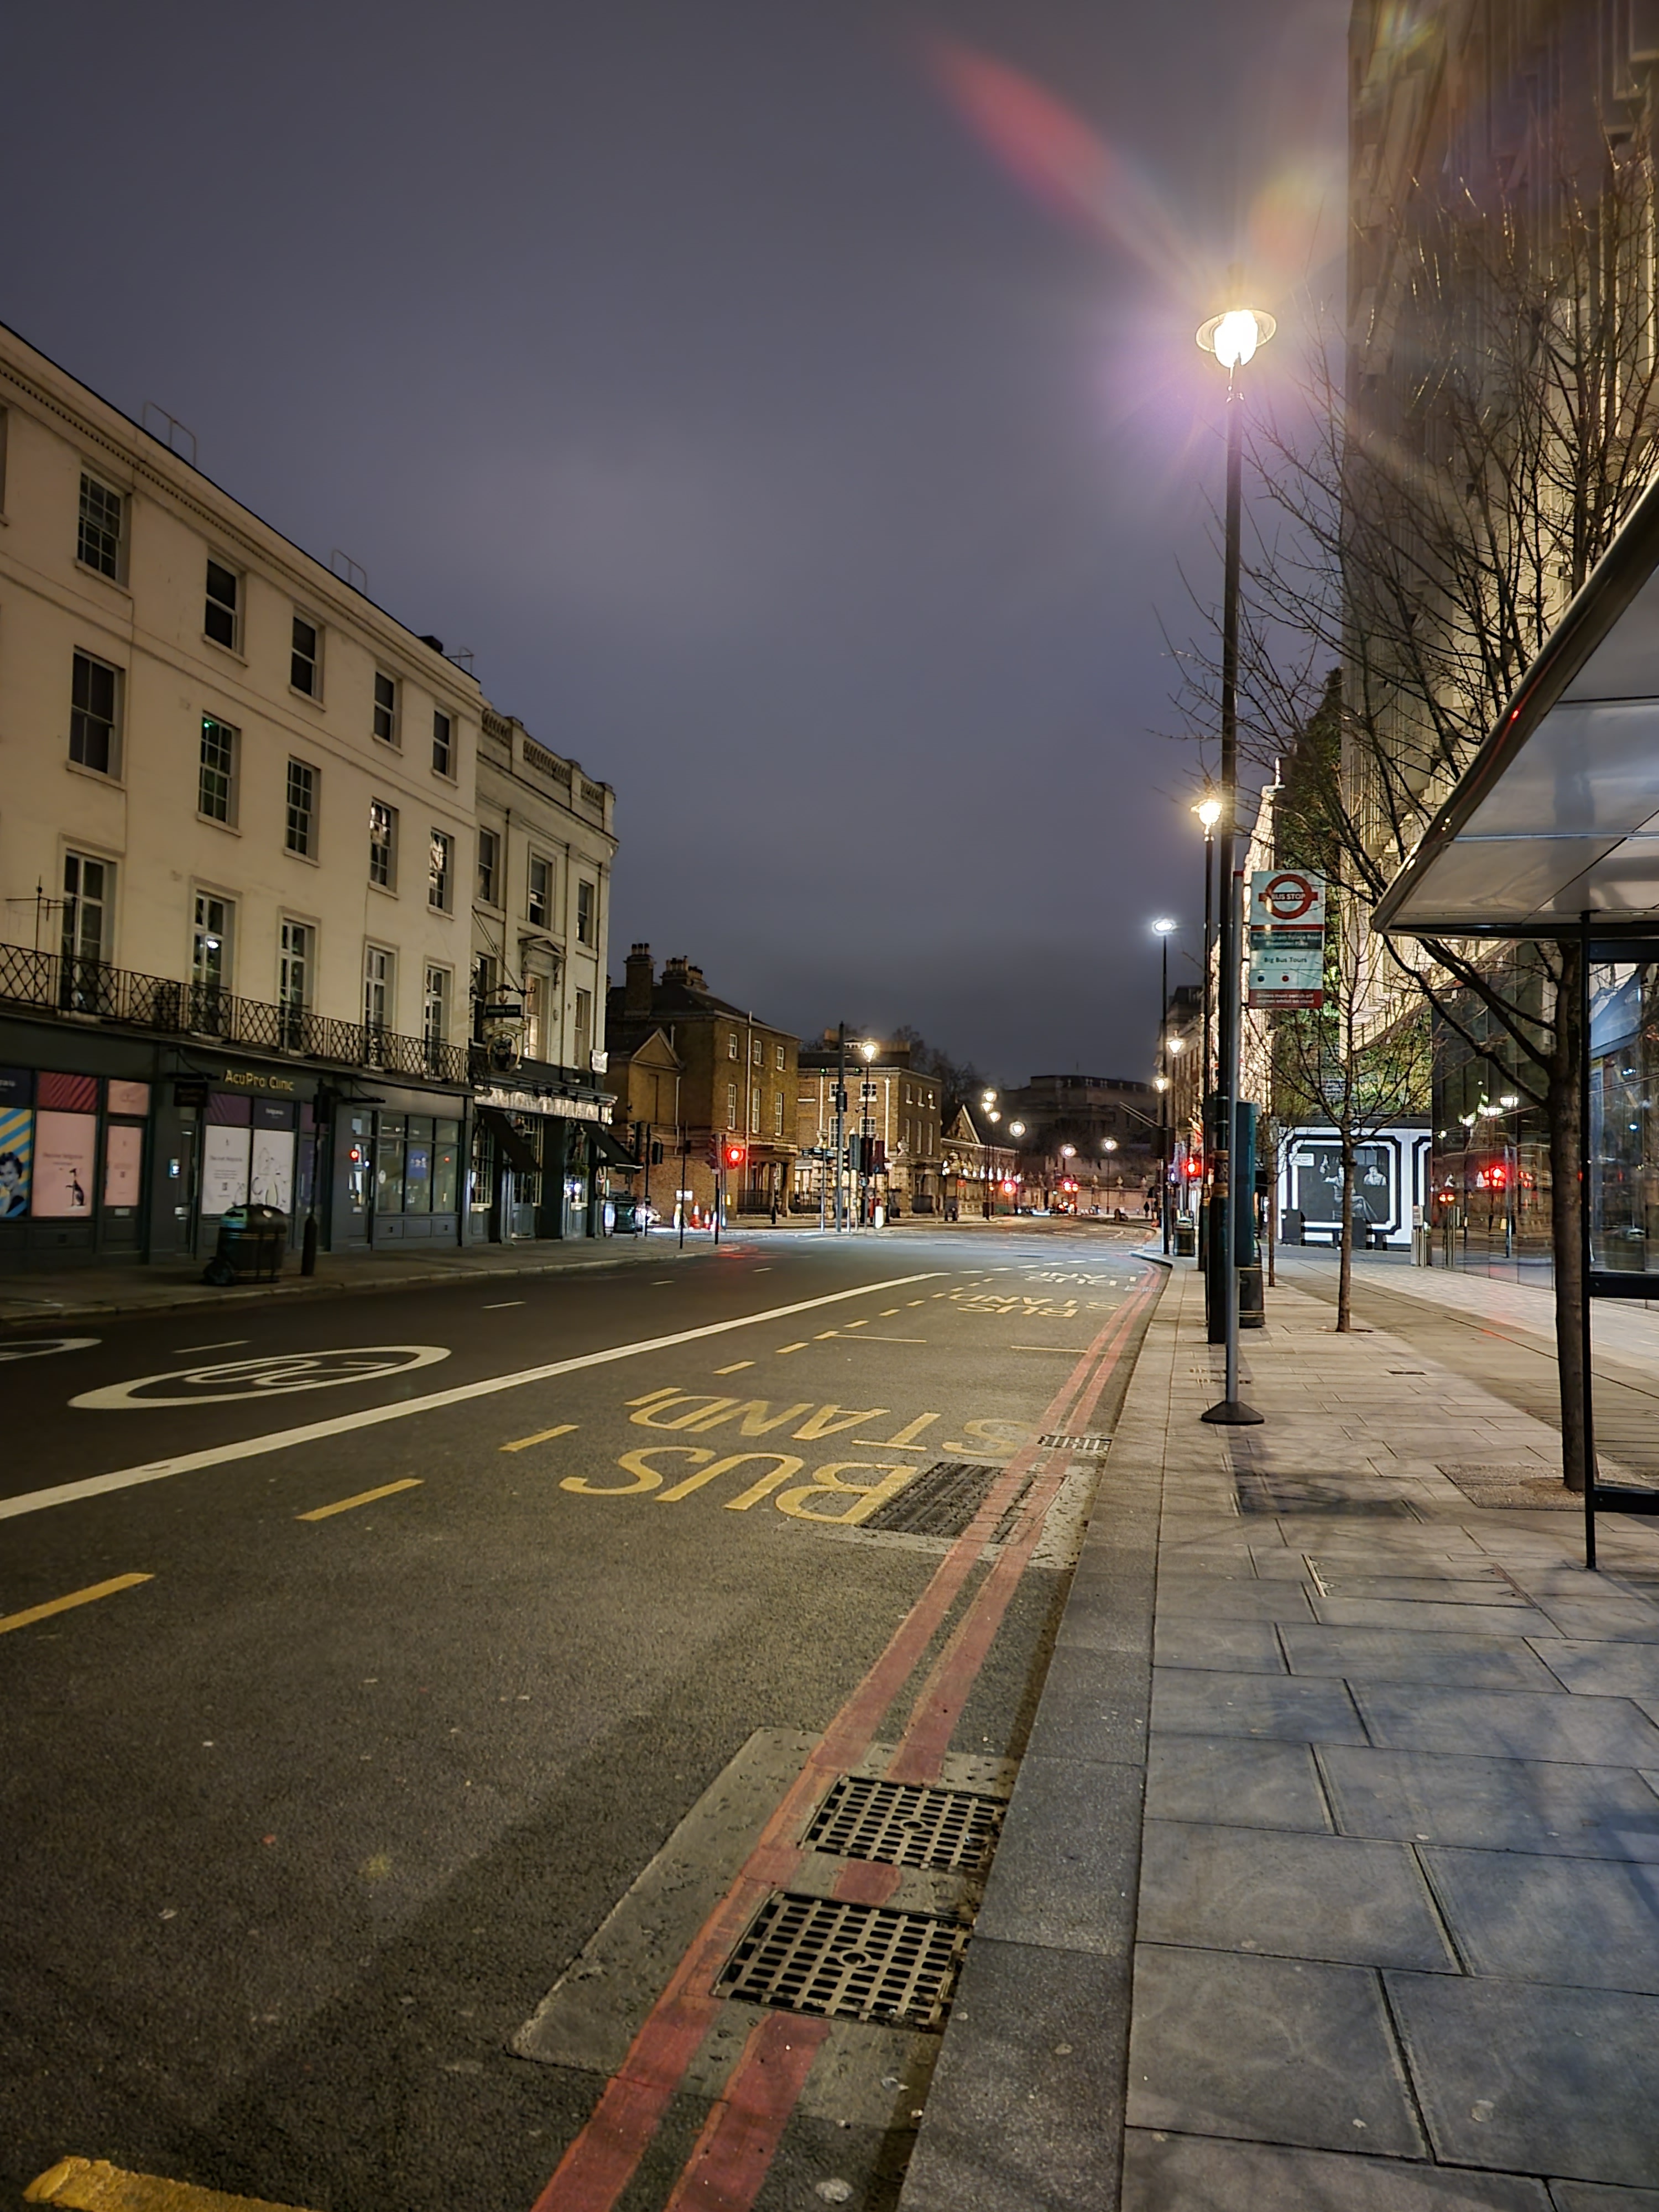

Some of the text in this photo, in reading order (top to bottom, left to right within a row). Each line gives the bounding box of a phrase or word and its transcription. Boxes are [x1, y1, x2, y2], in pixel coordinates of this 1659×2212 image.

[225, 1069, 295, 1091] AcuPro Clinic
[948, 1293, 1121, 1311] STAND
[957, 1303, 1079, 1318] BUS
[629, 1395, 1030, 1457] STAND
[560, 1446, 917, 1525] BUS
